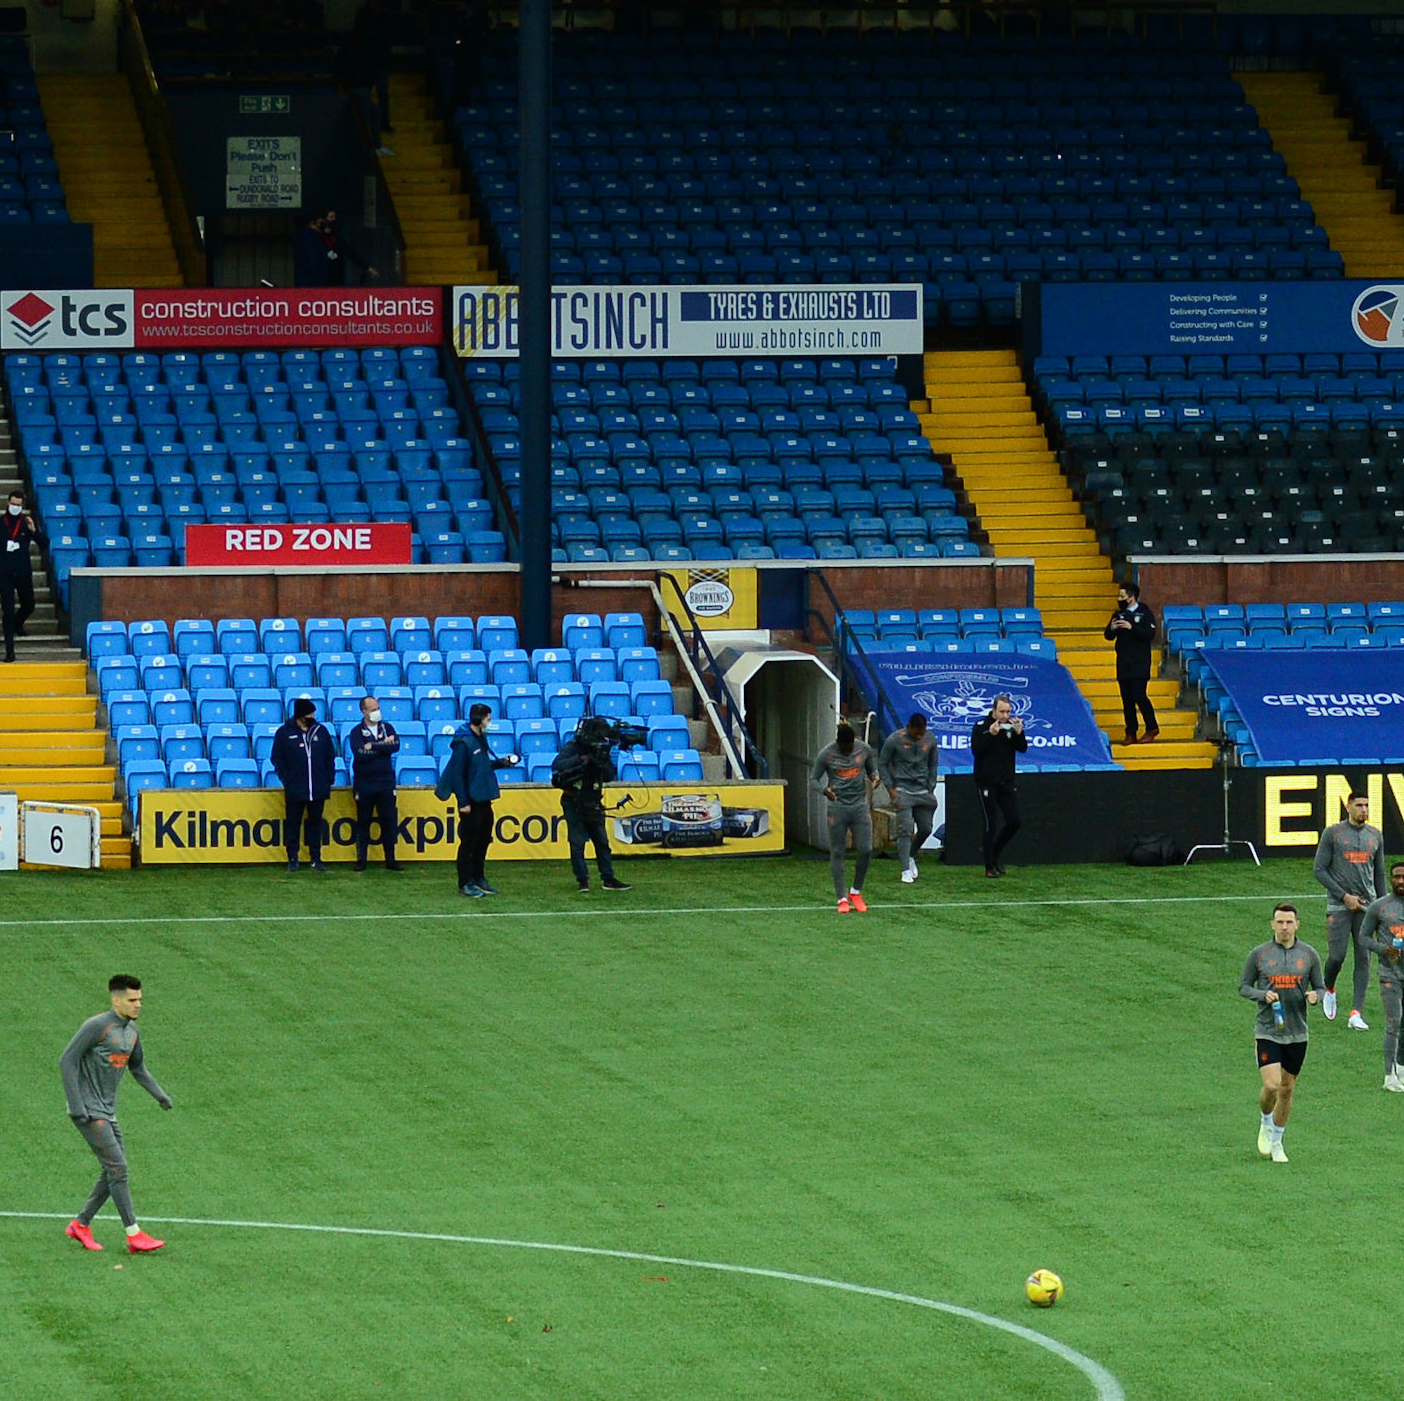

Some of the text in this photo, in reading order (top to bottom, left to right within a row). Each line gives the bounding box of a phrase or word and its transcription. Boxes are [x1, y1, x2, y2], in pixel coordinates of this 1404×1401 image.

[248, 139, 280, 150] EXITS
[231, 152, 297, 161] Please Don't
[252, 163, 277, 173] Push
[1170, 294, 1237, 302] Developing People
[141, 295, 435, 318] construction consultants
[709, 292, 890, 320] TYRES & EXHAUSTS LTD
[1170, 307, 1257, 316] Delivering Communities
[62, 296, 127, 336] tcs
[459, 292, 668, 349] ABBTSINCH
[143, 320, 433, 336] www.tcsconstructionconsultants.co.uk
[1170, 321, 1217, 329] Constructing
[716, 328, 881, 349] www.abbotsinch.com
[1170, 335, 1196, 343] Raising
[226, 529, 372, 550] RED ZONE
[689, 591, 729, 603] BROWNINGS
[1306, 706, 1380, 716] SIGNS
[50, 825, 63, 853] 6
